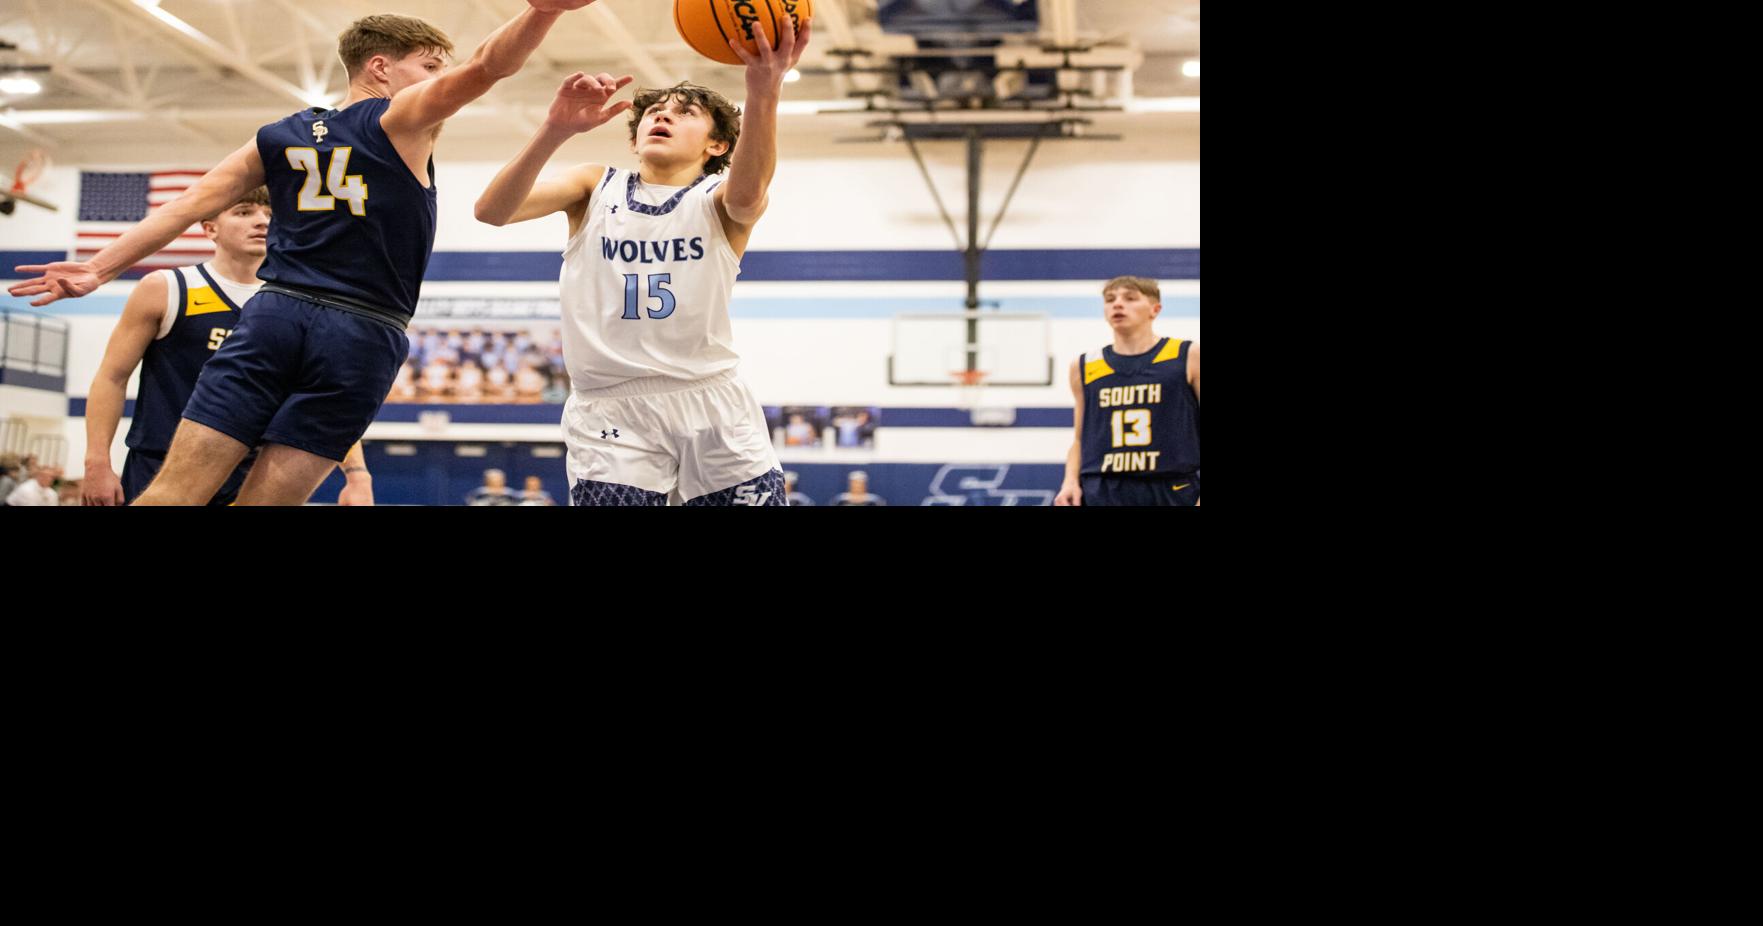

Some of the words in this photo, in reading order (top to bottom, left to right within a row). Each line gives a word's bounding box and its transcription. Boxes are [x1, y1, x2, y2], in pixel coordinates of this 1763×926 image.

[285, 146, 369, 217] 24
[601, 236, 704, 263] WOLVES
[621, 273, 676, 320] 15
[1098, 383, 1162, 408] SOUTH
[1111, 408, 1152, 448] 13
[1101, 450, 1161, 473] POINT
